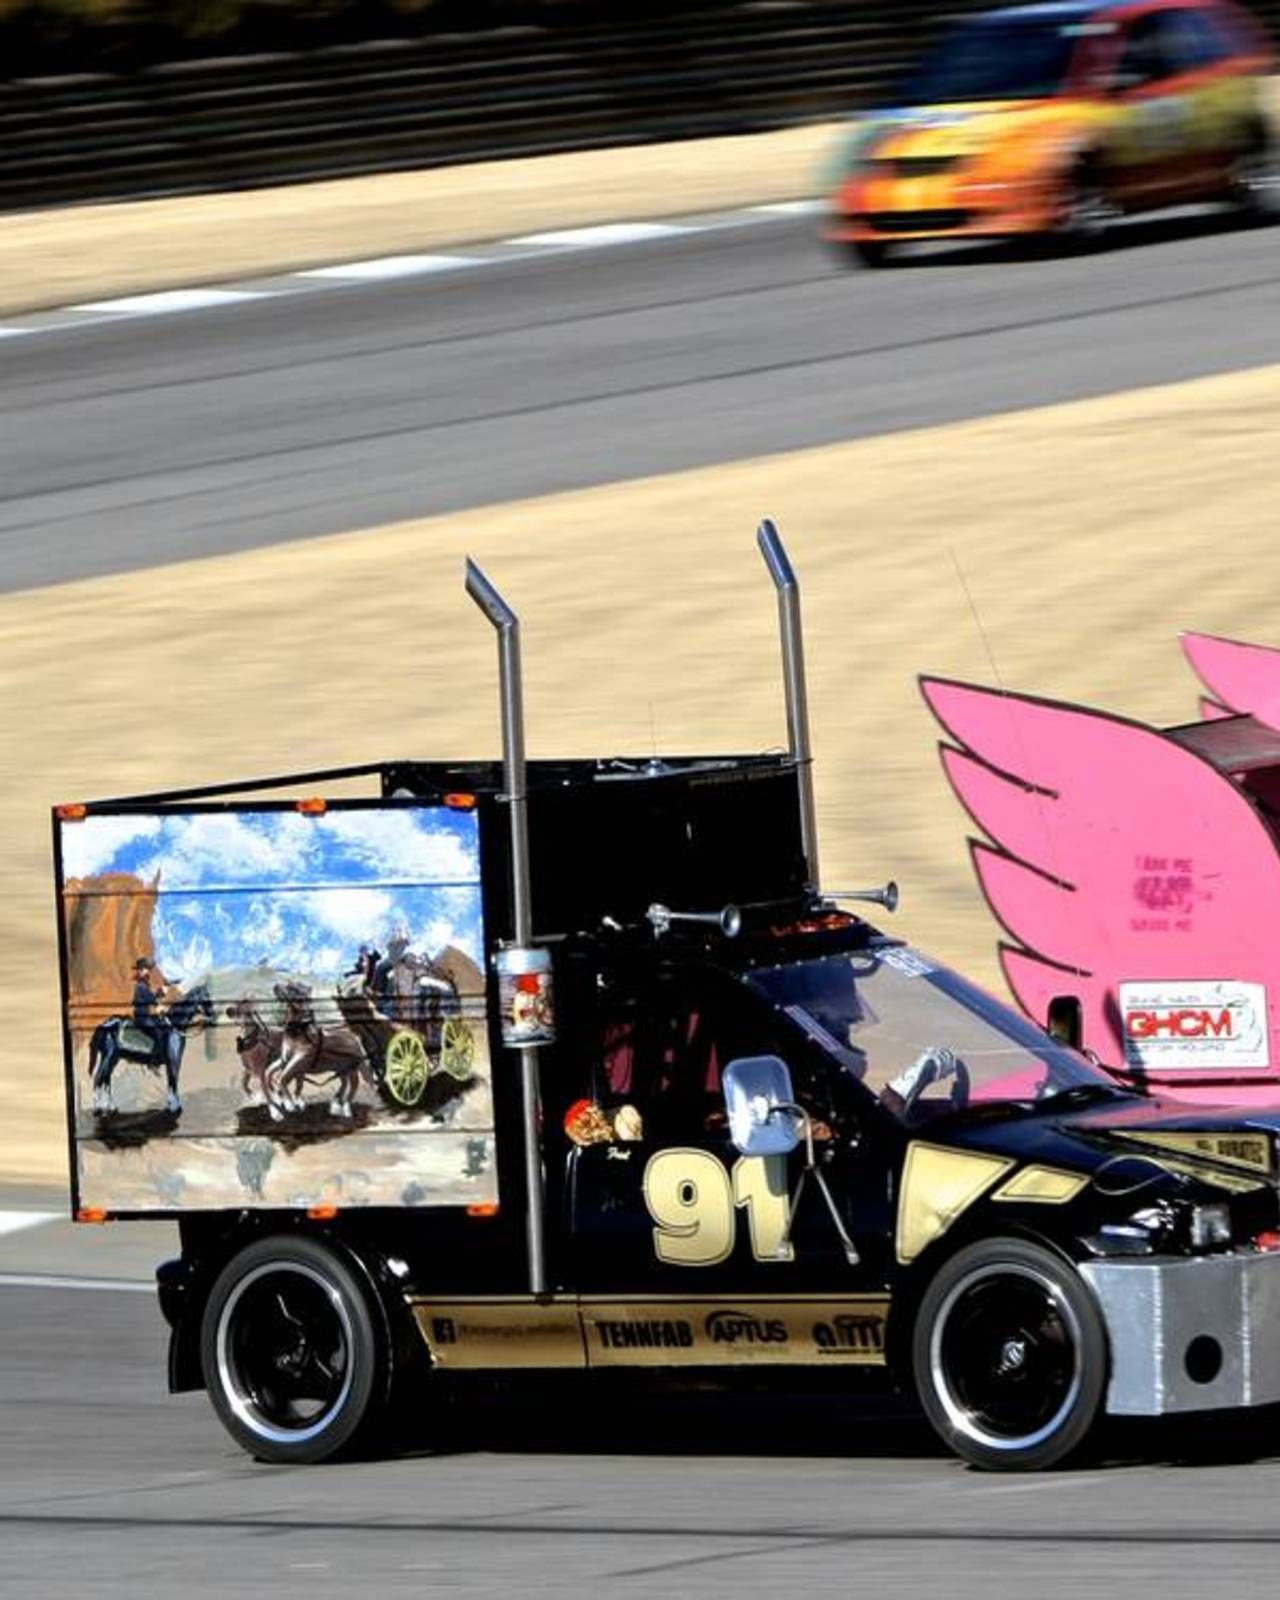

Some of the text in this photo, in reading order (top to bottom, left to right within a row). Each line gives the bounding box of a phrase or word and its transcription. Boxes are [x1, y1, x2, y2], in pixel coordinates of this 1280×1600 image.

[1125, 1008, 1233, 1039] GHCM
[643, 1147, 795, 1267] 91
[595, 1320, 693, 1348] TENNFAB
[711, 1318, 789, 1343] APTUS
